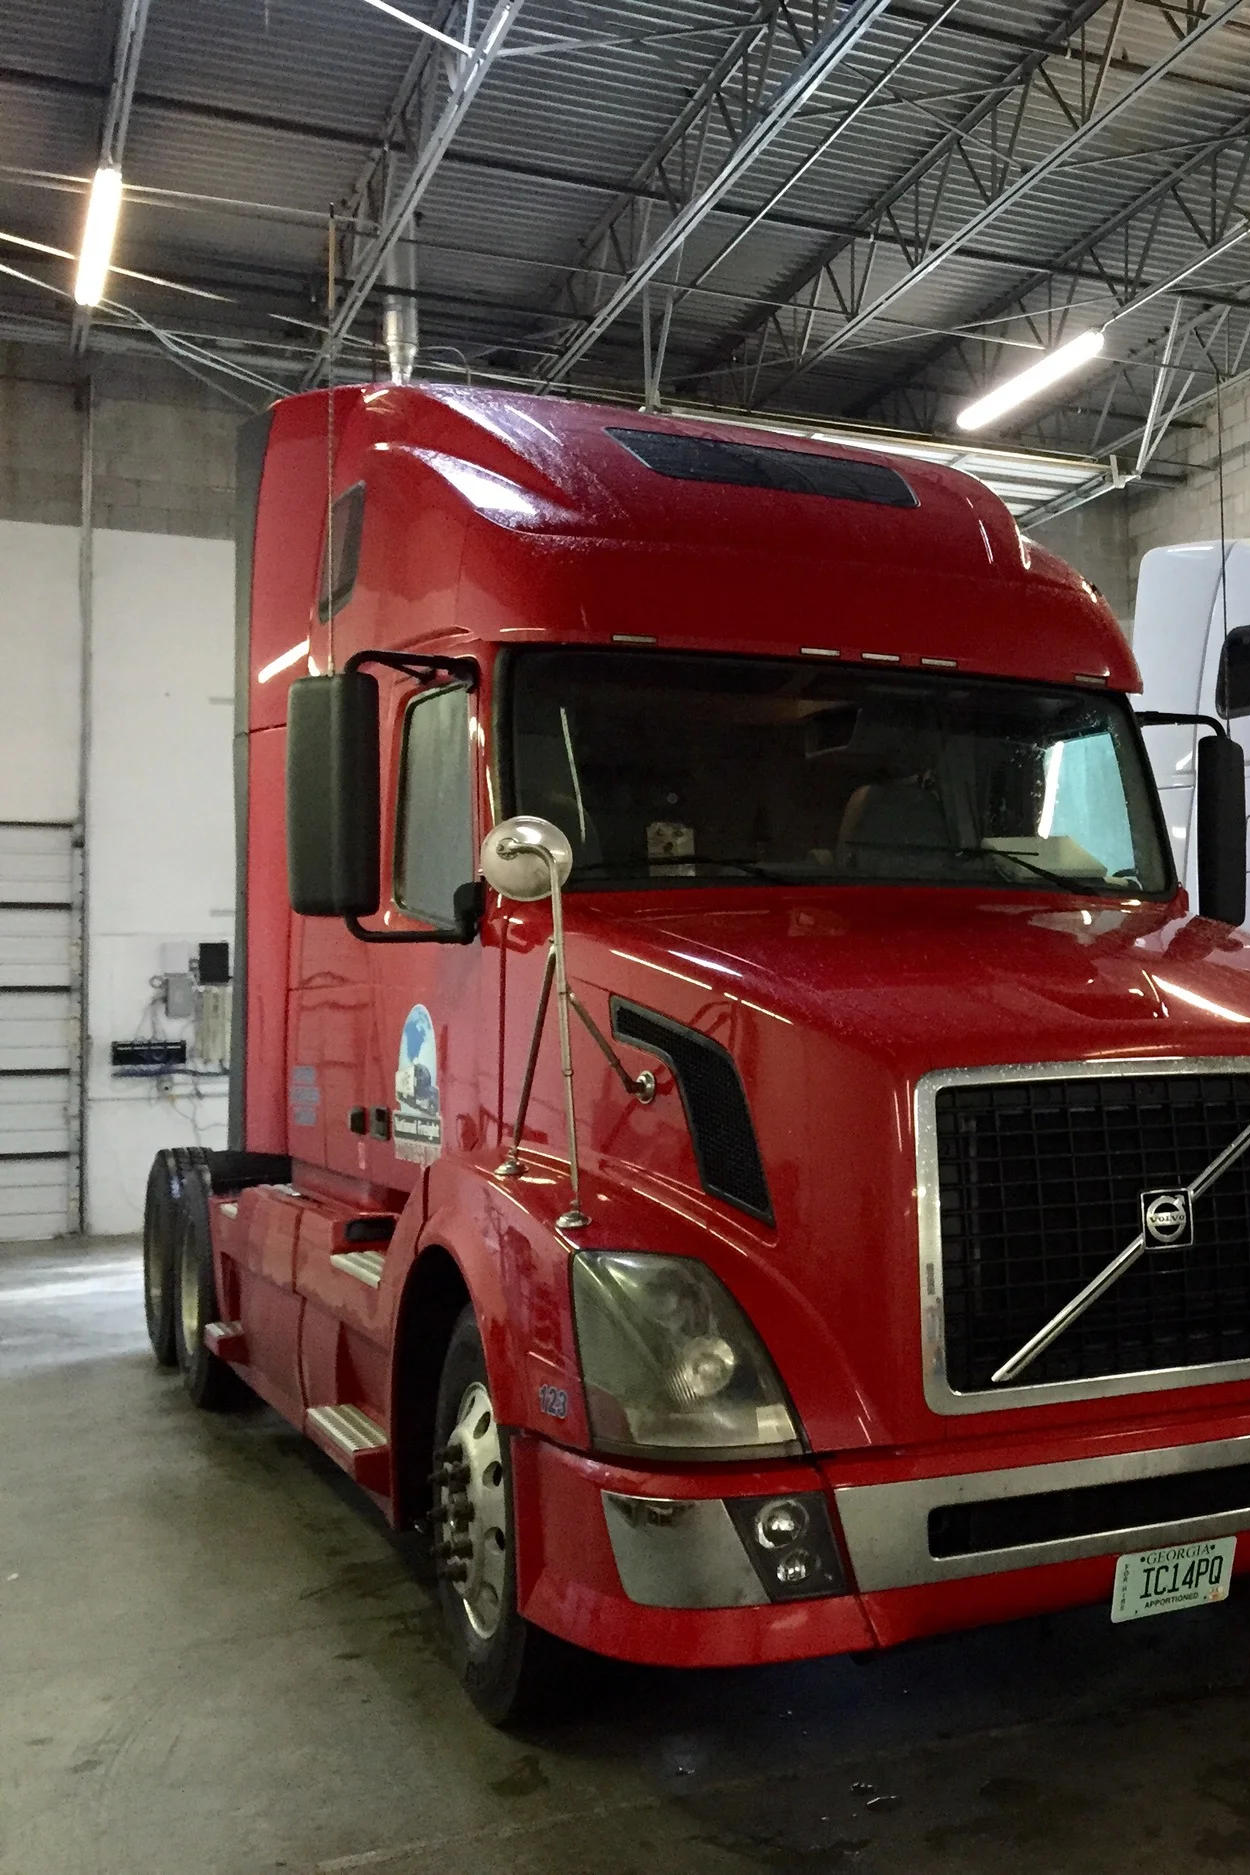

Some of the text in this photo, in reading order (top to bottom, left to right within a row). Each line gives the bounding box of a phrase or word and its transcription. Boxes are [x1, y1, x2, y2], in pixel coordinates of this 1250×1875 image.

[1149, 1214, 1185, 1223] VOLVO
[539, 1385, 567, 1418] 123
[1146, 1544, 1211, 1565] GEORGIA
[1139, 1555, 1224, 1600] IC14PQ
[1144, 1591, 1199, 1609] APPORTIONED
